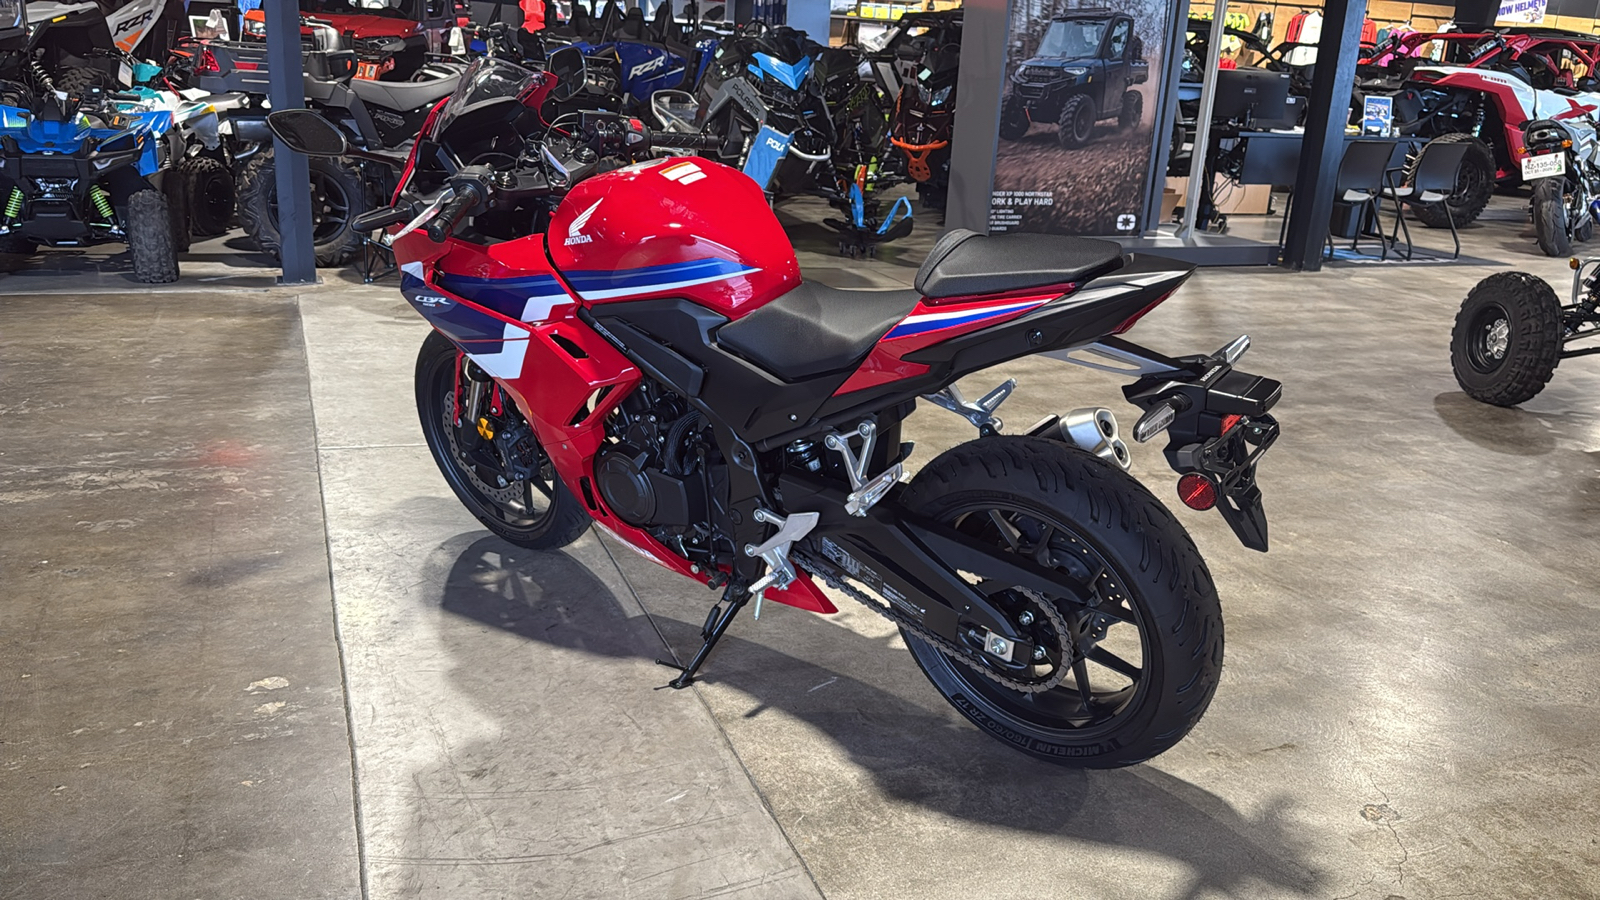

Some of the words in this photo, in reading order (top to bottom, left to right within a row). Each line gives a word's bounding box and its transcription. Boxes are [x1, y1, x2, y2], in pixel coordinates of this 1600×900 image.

[113, 9, 153, 37] RZR
[628, 56, 664, 80] RZR
[732, 83, 760, 115] POLARIS
[991, 198, 1006, 206] ORK
[1007, 198, 1013, 206] &
[1014, 198, 1033, 206] PLAY
[1034, 198, 1053, 206] HARD
[564, 235, 593, 246] HONDA
[415, 295, 451, 305] CBR
[1200, 365, 1222, 381] HONDA
[955, 698, 970, 709] 17
[970, 708, 986, 722] ZR
[987, 721, 1027, 745] 160/60
[1036, 742, 1099, 757] MICHELIN
